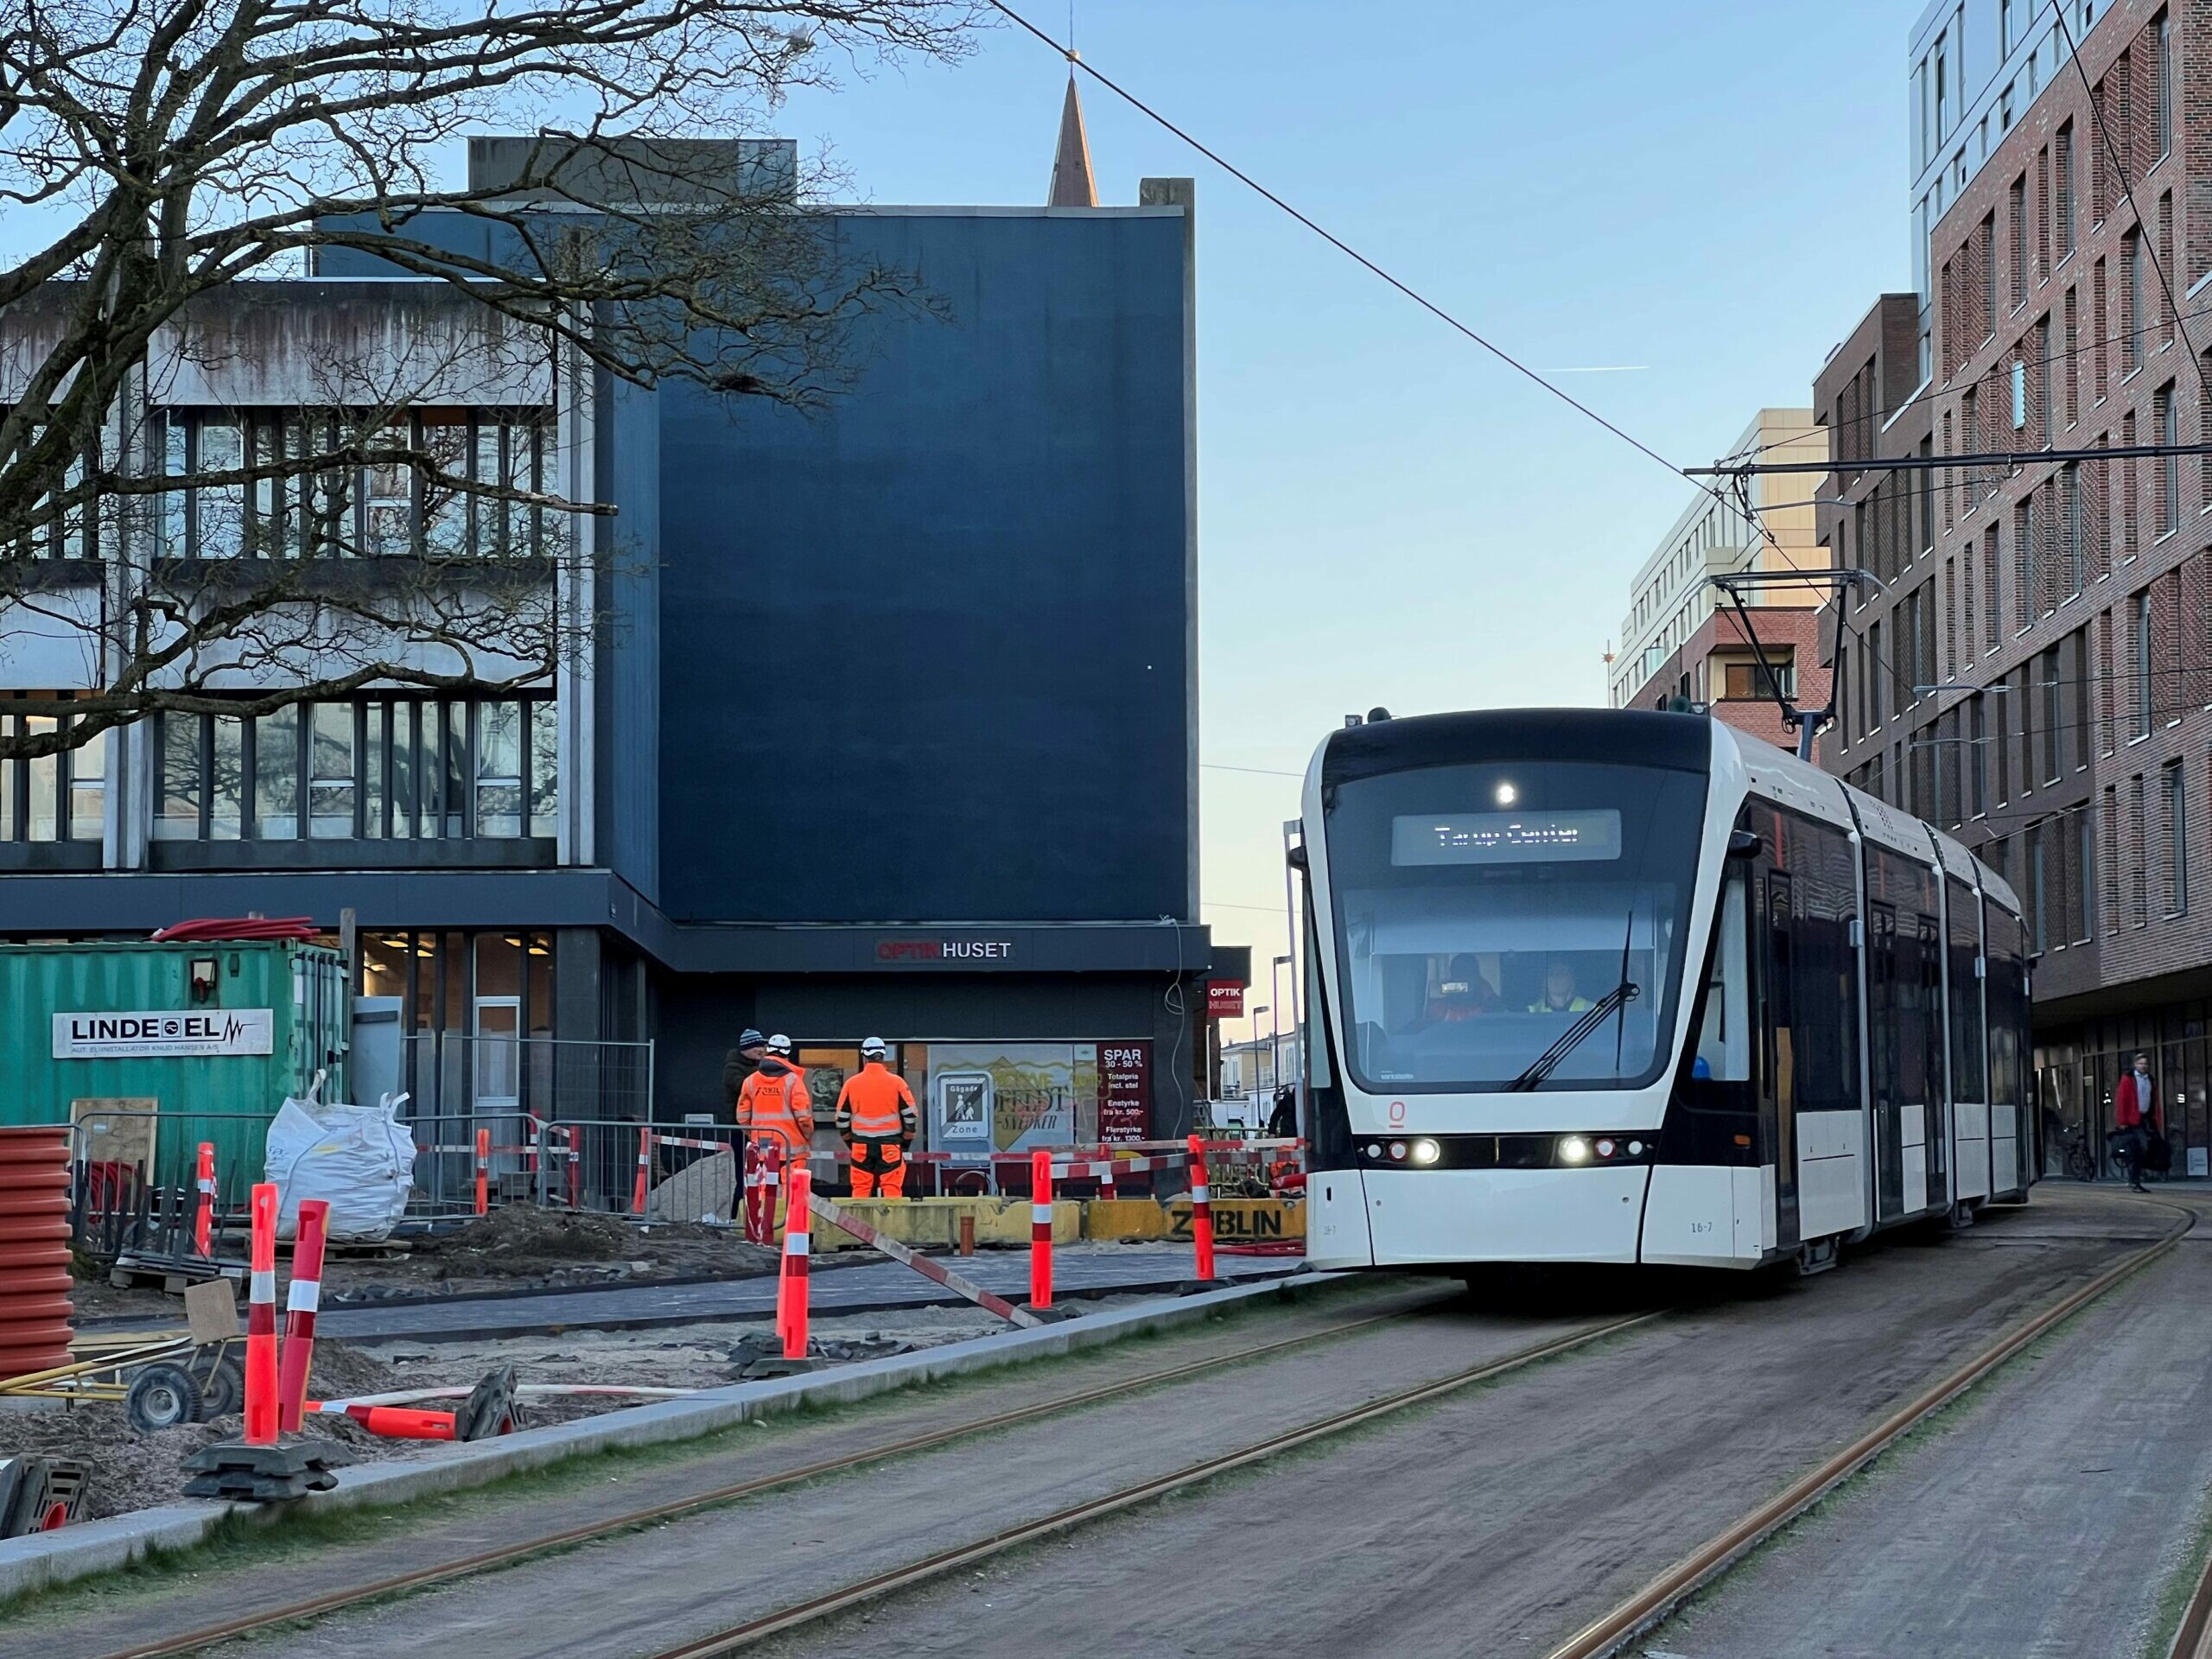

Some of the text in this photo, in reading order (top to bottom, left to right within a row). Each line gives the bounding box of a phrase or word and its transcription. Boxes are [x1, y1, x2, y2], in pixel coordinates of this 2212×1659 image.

[1210, 988, 1241, 997] OPTIK
[72, 1017, 220, 1039] LINDE EL
[1103, 1049, 1141, 1061] SPAR
[952, 1125, 977, 1134] Zone
[1106, 1127, 1142, 1135] Flerstyrke
[1172, 1210, 1281, 1235] ZBLIN
[1692, 1222, 1712, 1233] 16-7
